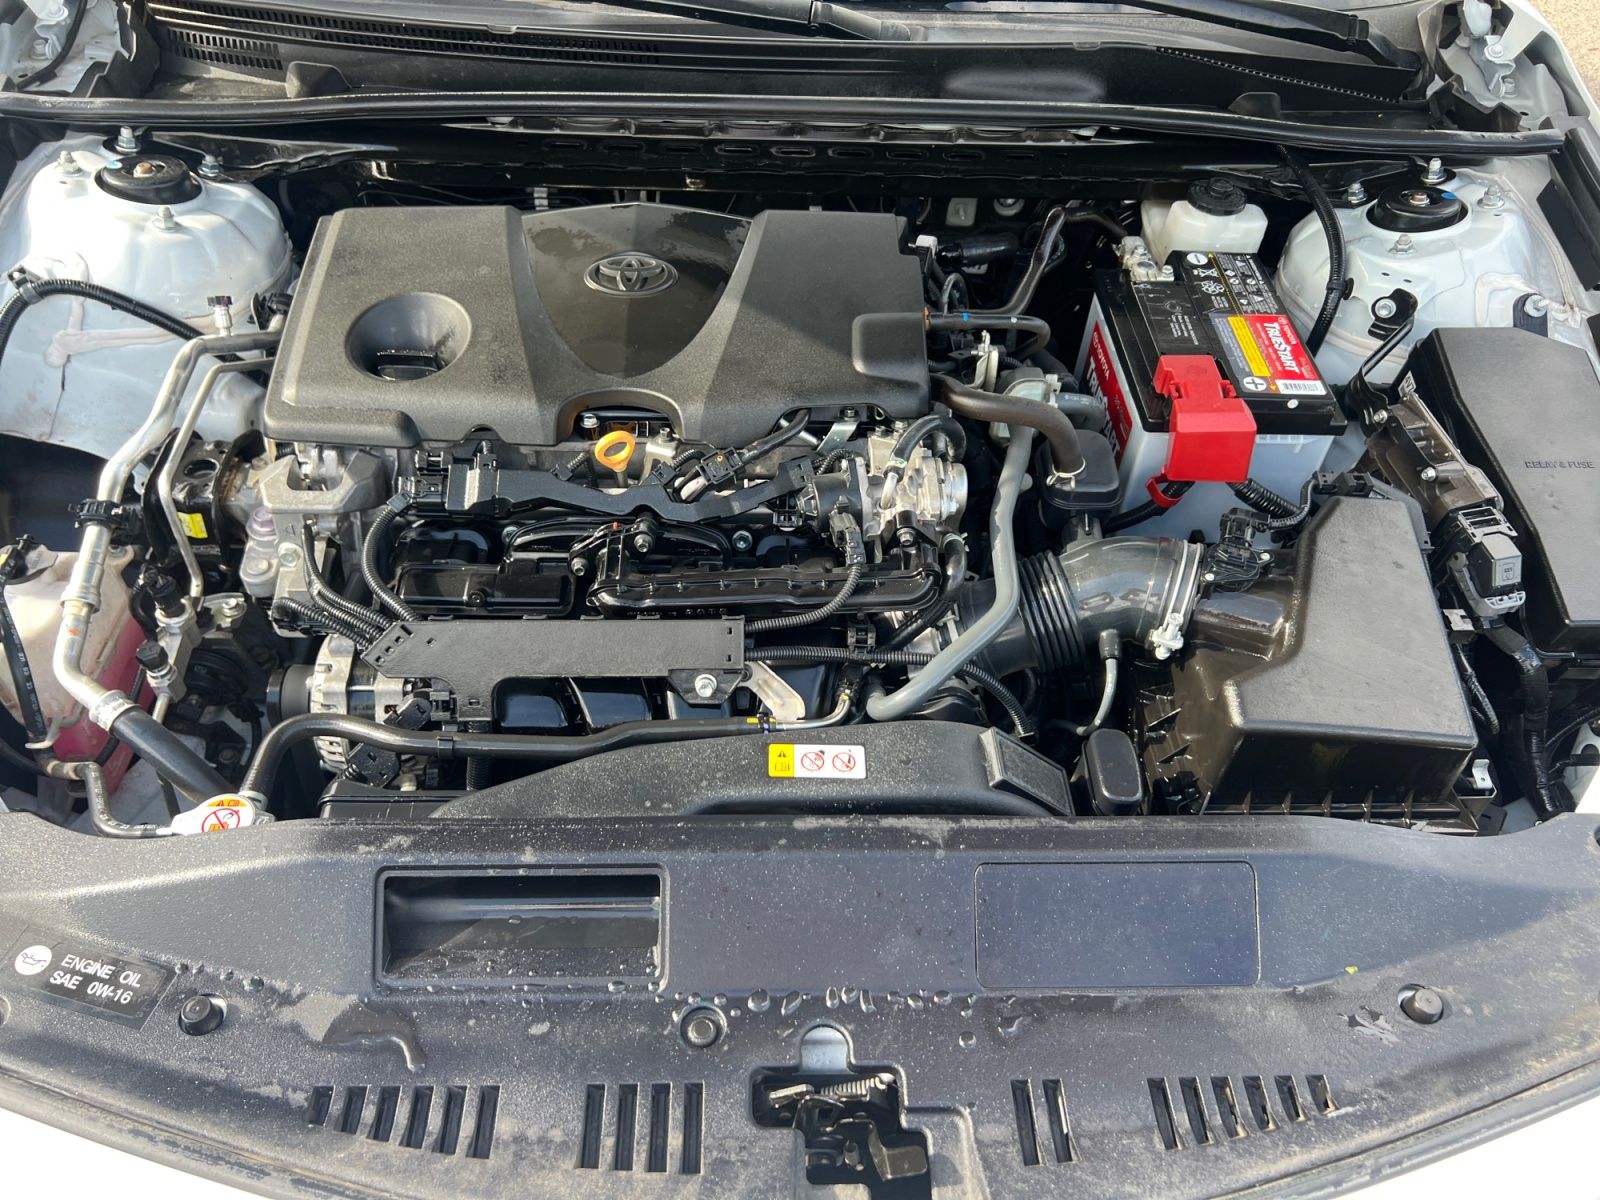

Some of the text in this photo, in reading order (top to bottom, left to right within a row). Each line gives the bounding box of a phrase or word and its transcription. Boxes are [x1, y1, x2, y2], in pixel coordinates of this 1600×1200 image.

[1282, 323, 1297, 345] TOYOTA
[1096, 346, 1110, 380] TOYOTA
[1524, 460, 1557, 469] RELAY
[1567, 461, 1596, 469] FUSE
[49, 970, 133, 1004] SAE 0W-16
[61, 954, 142, 988] ENGINE OIL
